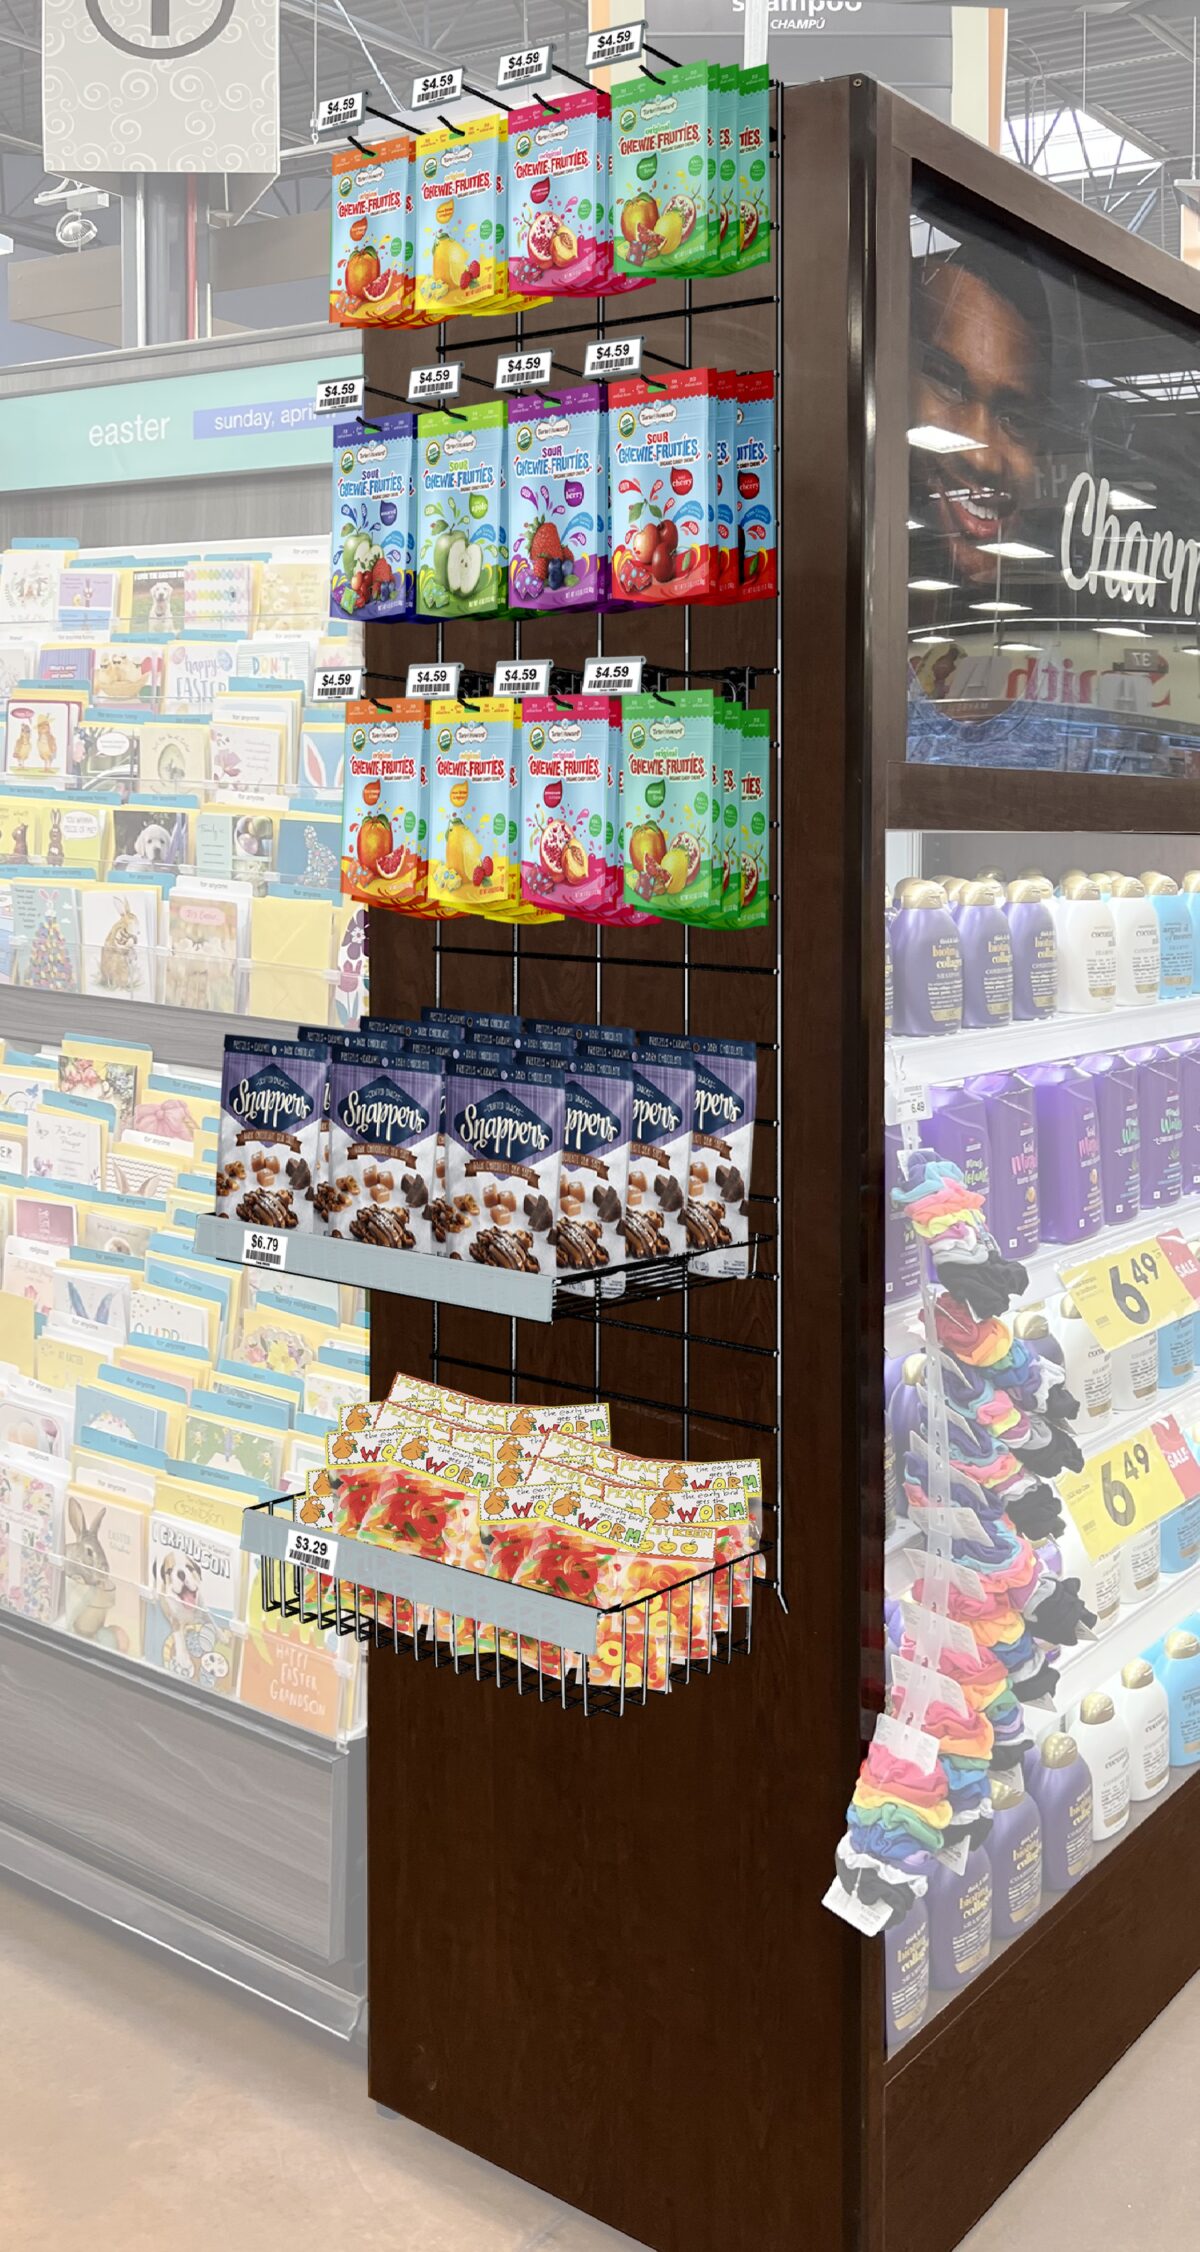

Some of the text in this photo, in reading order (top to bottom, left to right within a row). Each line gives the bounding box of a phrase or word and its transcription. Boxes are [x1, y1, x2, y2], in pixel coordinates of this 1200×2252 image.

[732, 0, 862, 17] sampoo
[770, 18, 826, 30] CHAMPÚ
[597, 31, 631, 48] $4.59
[508, 51, 540, 69] $4.59
[422, 74, 454, 91] $4.59
[327, 97, 355, 115] $4.59
[596, 344, 630, 360] $4.59
[508, 357, 541, 372] $4.59
[419, 370, 450, 384] $4.59
[325, 382, 355, 397] $4.59
[214, 410, 275, 431] sunday,
[89, 414, 171, 447] easter
[647, 431, 669, 445] SOUR
[542, 446, 562, 458] SOUR
[361, 468, 379, 479] SOUR
[672, 478, 692, 487] cherry
[565, 490, 582, 500] berry
[185, 653, 217, 679] happy
[252, 656, 291, 675] DON'T
[595, 666, 629, 679] $4.59
[322, 674, 351, 687] $4.59
[417, 671, 447, 683] $4.59
[504, 668, 537, 682] $4.59
[233, 1079, 311, 1128] Snappers
[343, 1090, 426, 1141] Snappers
[460, 1103, 550, 1159] Snappers
[564, 1108, 618, 1150] ppers
[251, 1234, 279, 1251] $6.79
[1175, 1259, 1199, 1279] SALE
[1109, 1252, 1159, 1325] 6 49
[468, 1405, 504, 1418] PEAC
[380, 1430, 400, 1438] earl
[537, 1418, 606, 1434] WORM
[455, 1431, 491, 1443] PEAC
[360, 1444, 397, 1462] WO
[1166, 1447, 1189, 1469] SALE
[425, 1456, 490, 1488] WORM
[620, 1461, 657, 1473] PEAC
[532, 1486, 551, 1494] earl
[690, 1475, 758, 1490] WORM
[1101, 1443, 1150, 1527] 6 49
[606, 1488, 644, 1500] PEAC
[512, 1500, 547, 1518] WO
[676, 1502, 745, 1523] WORM
[578, 1512, 642, 1543] WORM
[672, 1528, 713, 1539] KEEN
[158, 1525, 231, 1579] GRANDSON
[295, 1535, 328, 1556] $3.29
[276, 1643, 309, 1669] HAPPY
[269, 1679, 326, 1717] GRANDSON
